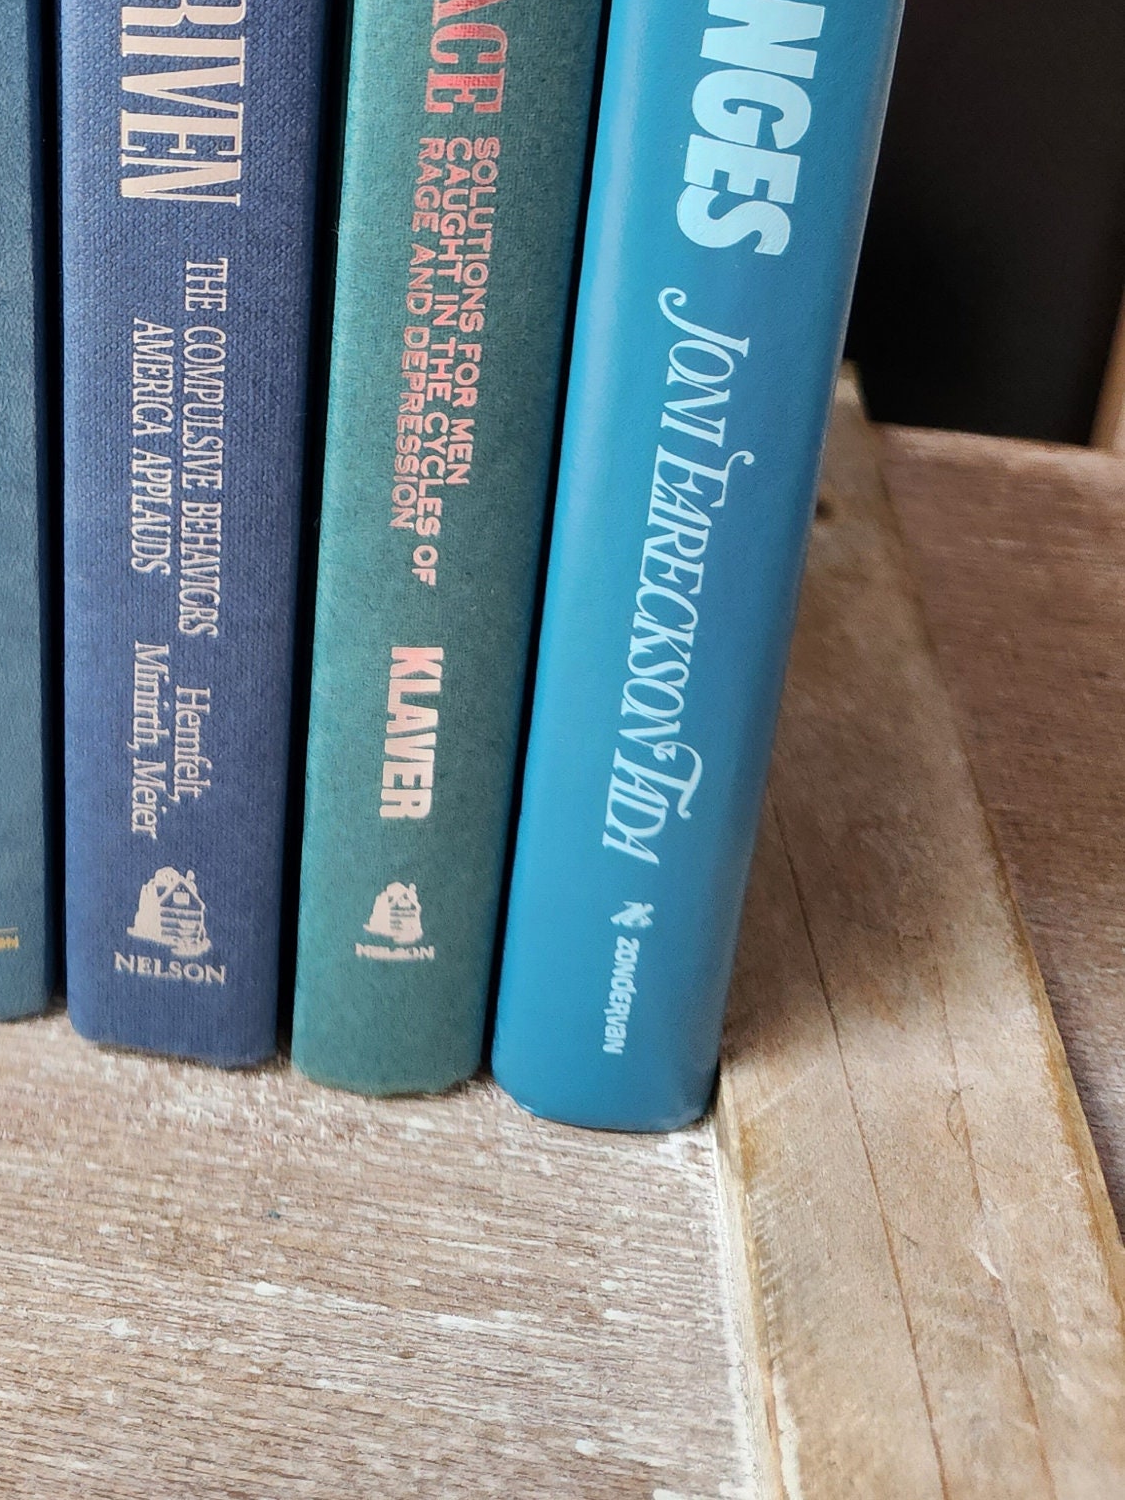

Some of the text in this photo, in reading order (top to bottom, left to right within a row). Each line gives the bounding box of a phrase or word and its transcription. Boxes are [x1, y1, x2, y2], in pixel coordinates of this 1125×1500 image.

[129, 317, 175, 577] AMERICA APPLAUDS
[177, 257, 228, 639] THE COMPULSIVE BEHAVIORS
[387, 137, 446, 530] RAGE AND DEPRESSION
[411, 137, 473, 587] CAUGHT IN THE CYCLES OF
[444, 136, 501, 486] SOLUTIONS FOR MEN
[602, 286, 755, 866] JONI EARECKSON TADA
[126, 640, 170, 842] Minirth, Meier
[167, 685, 213, 802] Hemfelt,
[380, 645, 446, 820] KLAVER
[113, 951, 227, 986] NELSON
